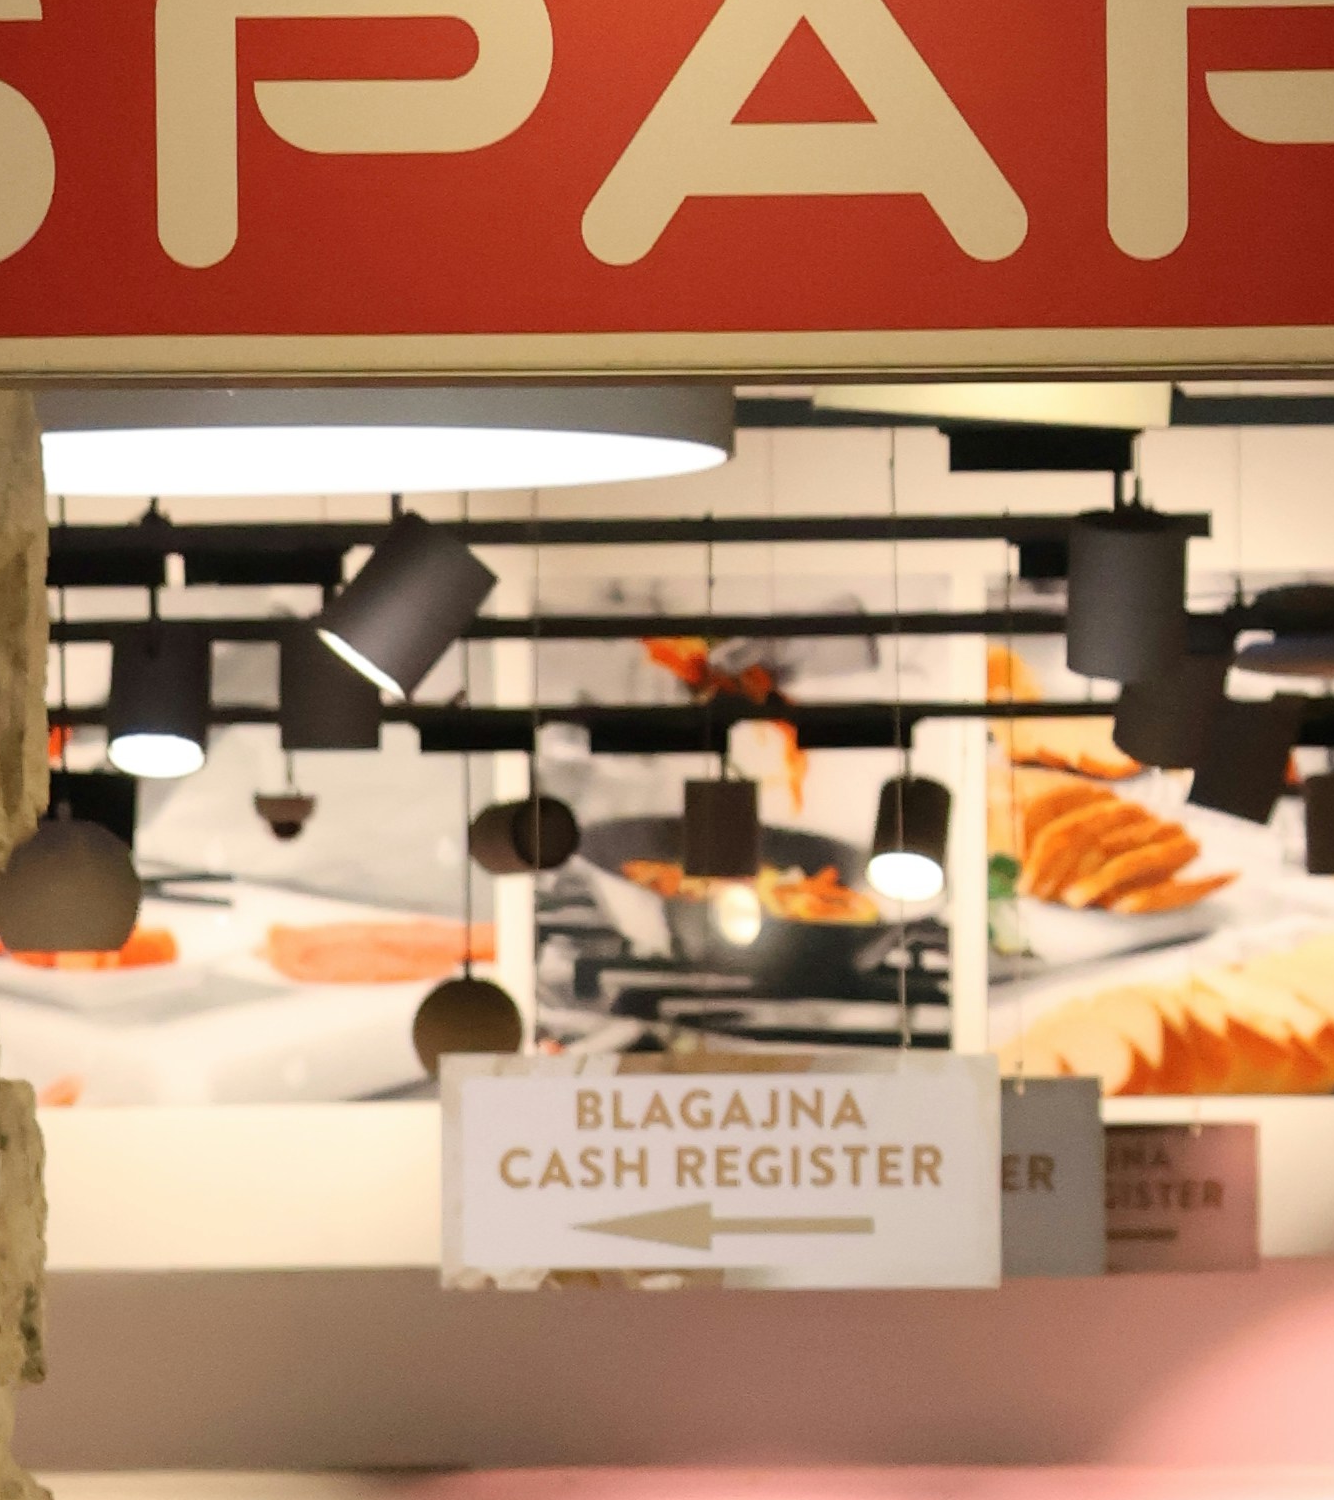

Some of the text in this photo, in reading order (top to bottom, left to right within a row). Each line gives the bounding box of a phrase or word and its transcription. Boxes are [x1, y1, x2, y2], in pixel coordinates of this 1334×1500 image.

[575, 1088, 867, 1131] BLAGAJNA
[498, 1144, 944, 1189] CASH REGISTER
